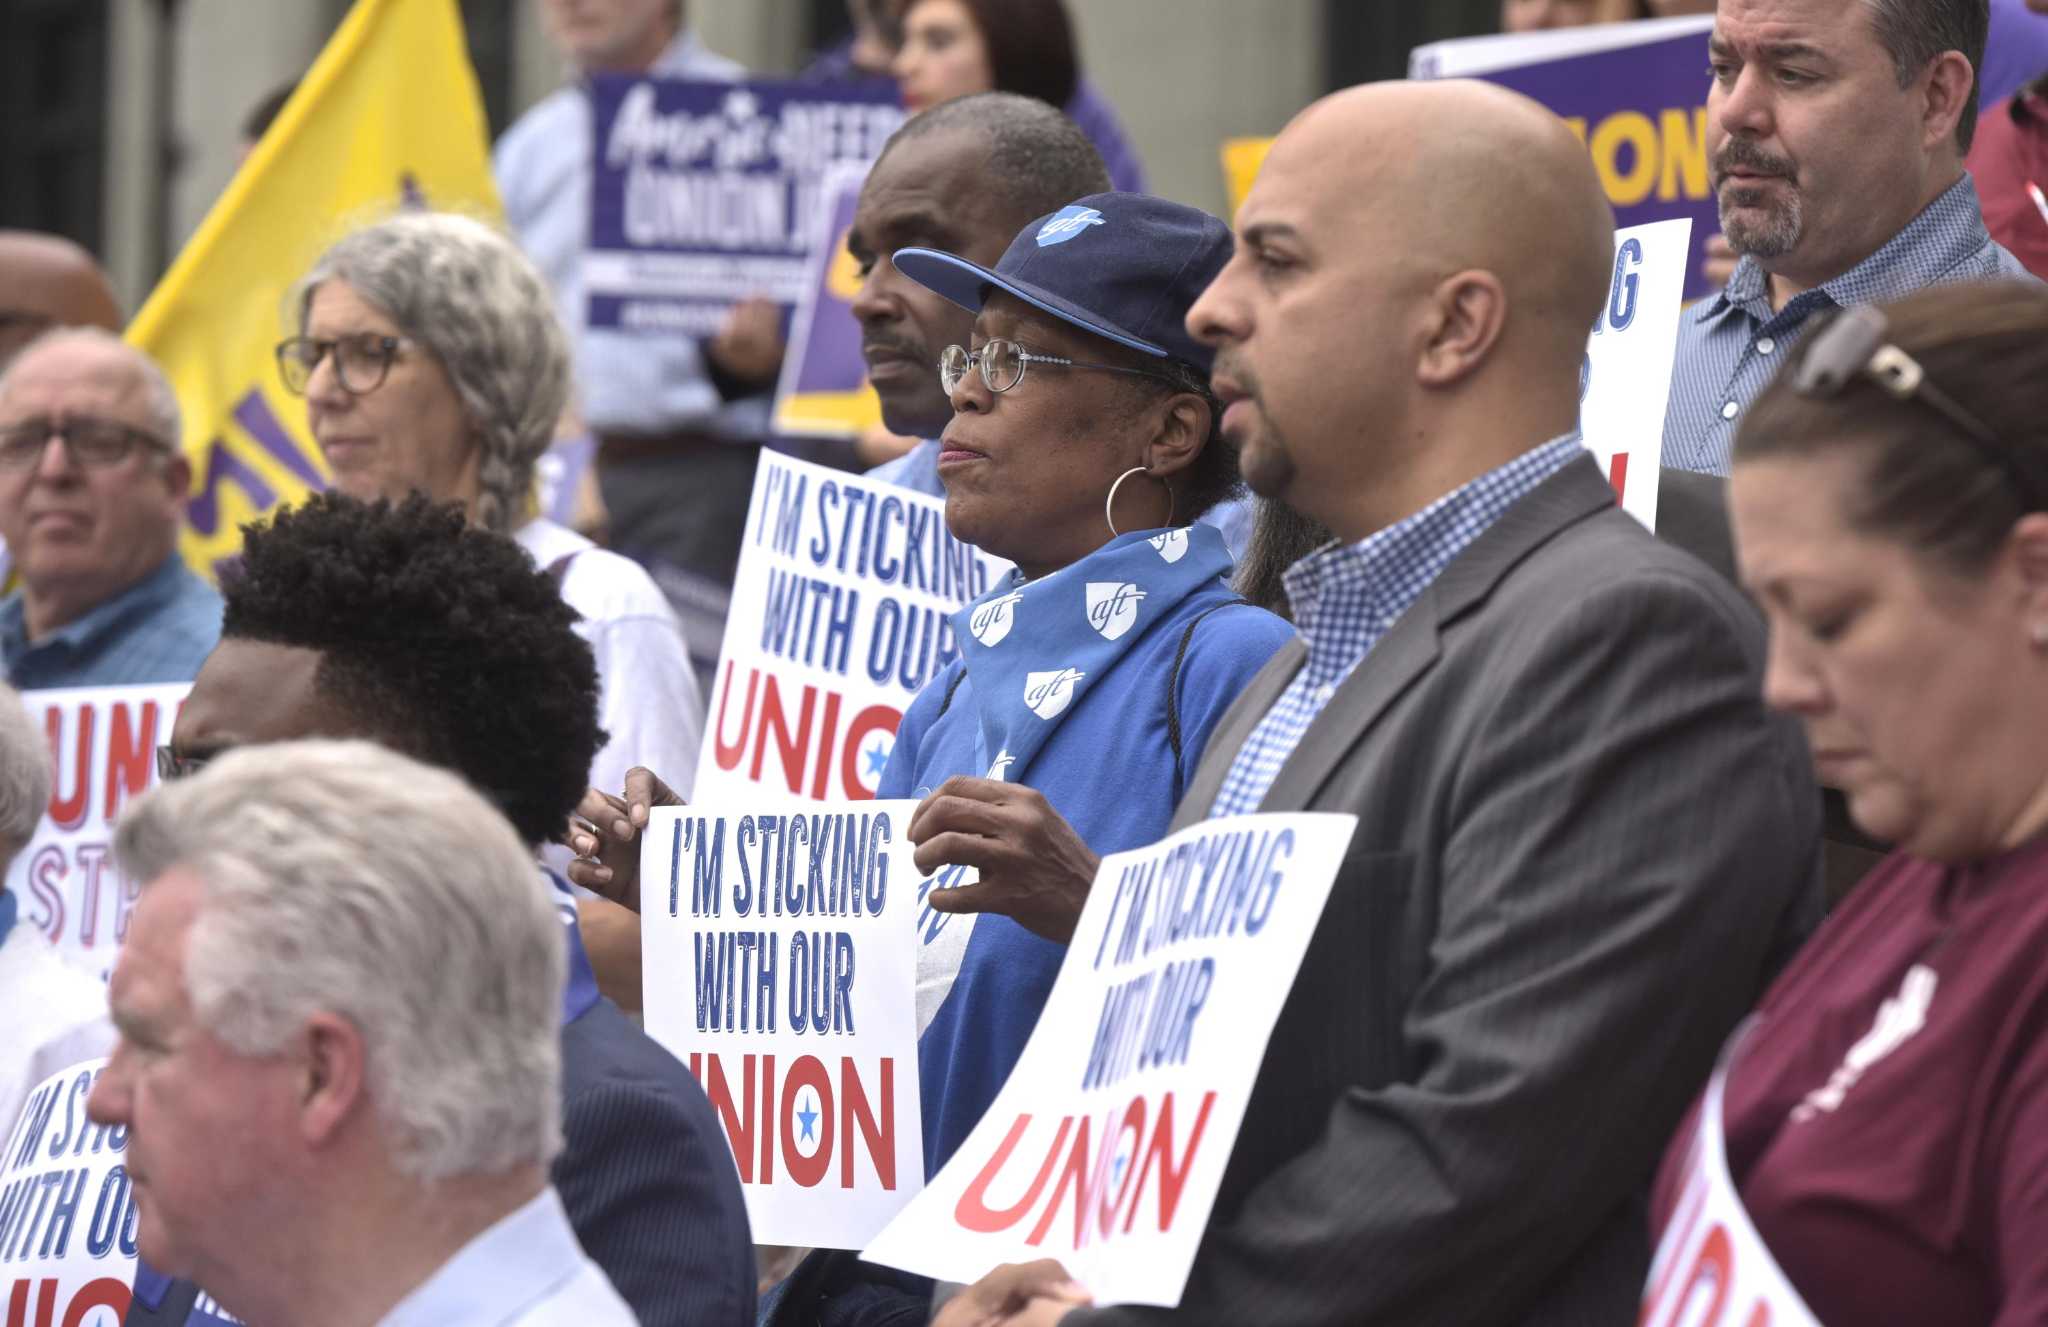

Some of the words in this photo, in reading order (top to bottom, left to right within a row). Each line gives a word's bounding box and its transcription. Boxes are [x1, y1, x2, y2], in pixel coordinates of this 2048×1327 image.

[761, 566, 860, 676] WITH
[1092, 583, 1145, 632] aft
[713, 659, 904, 802] UNIO
[1027, 667, 1084, 711] aft
[669, 816, 728, 917] I'M
[732, 812, 893, 917] STICKING
[694, 930, 779, 1033] WITH
[788, 930, 857, 1035] OUR
[689, 1052, 897, 1192] NION
